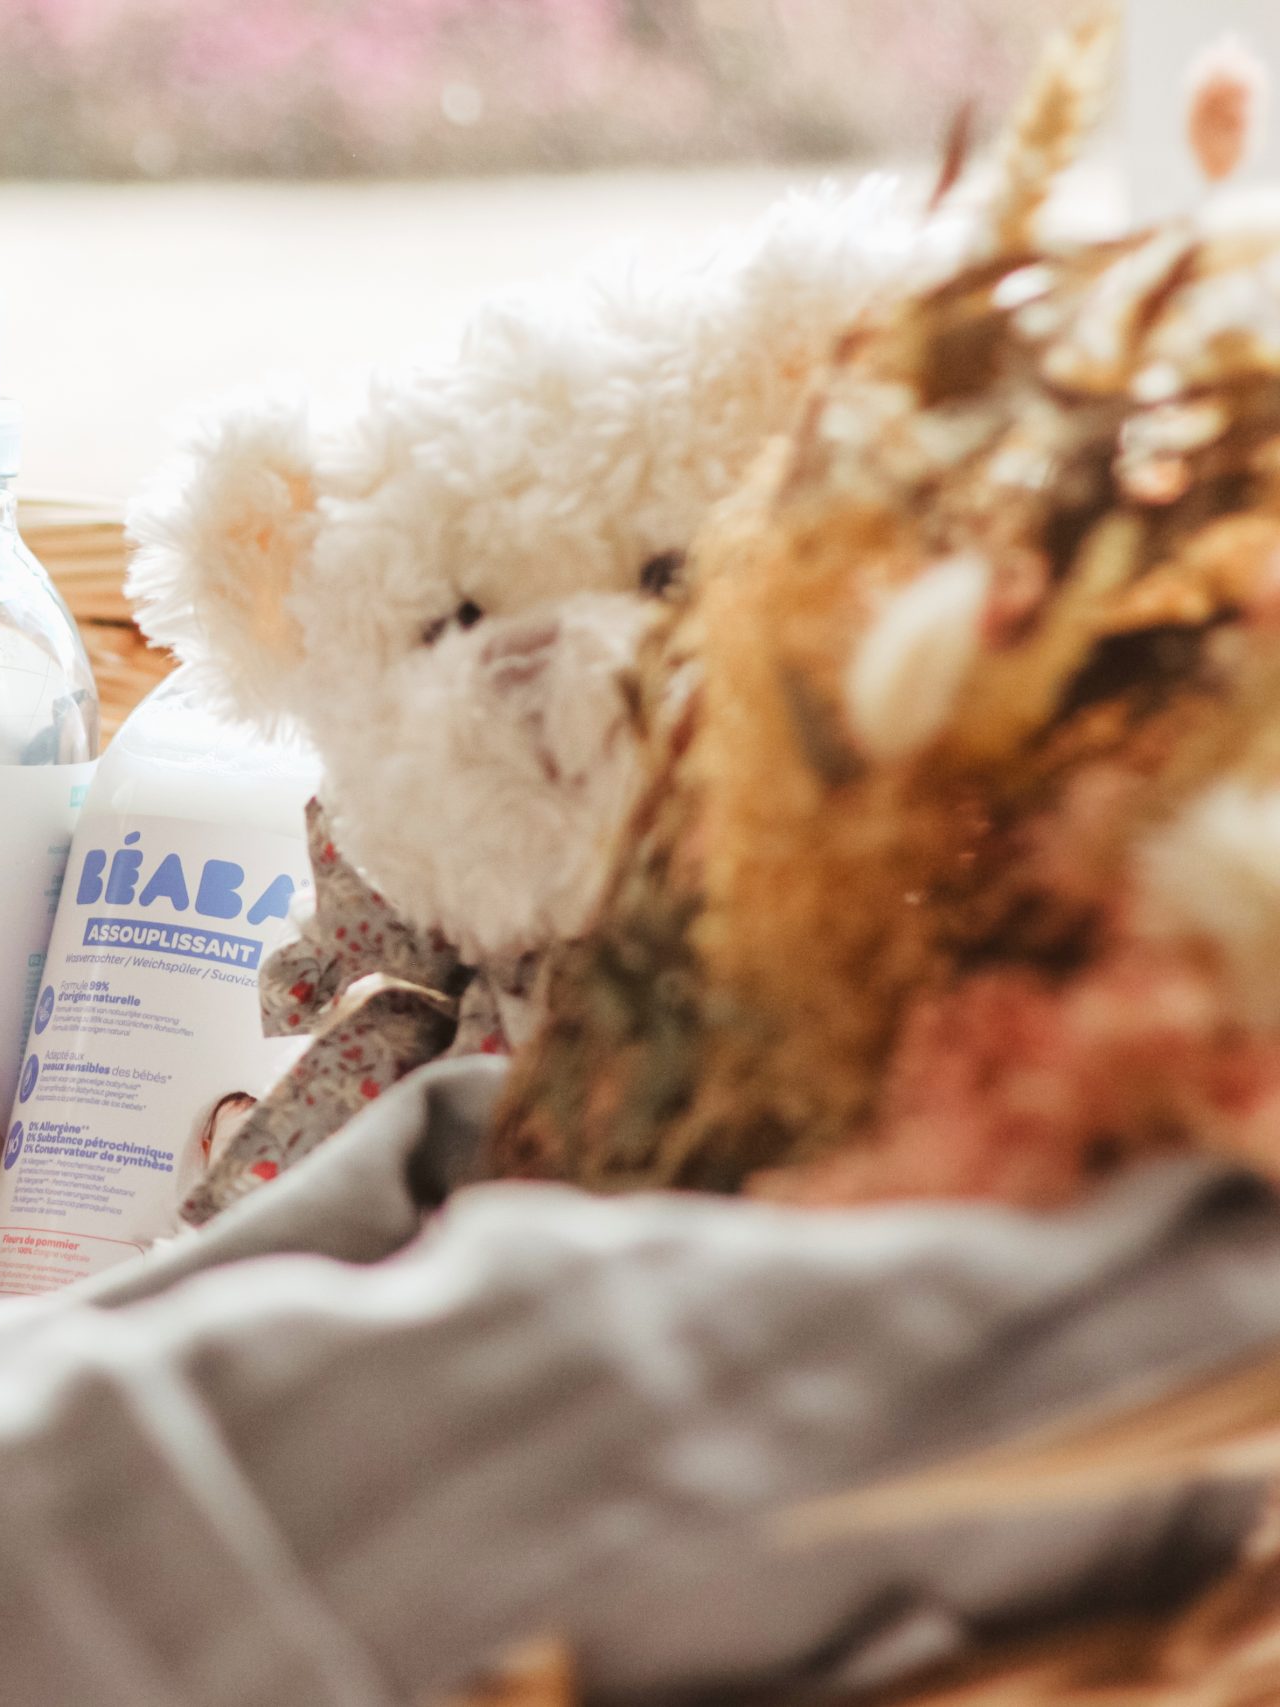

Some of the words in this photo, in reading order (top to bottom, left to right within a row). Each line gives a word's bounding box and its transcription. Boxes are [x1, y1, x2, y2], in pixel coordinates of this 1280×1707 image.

[76, 831, 295, 926] BÉABA
[88, 924, 255, 963] ASSOUPLISSANT
[66, 953, 123, 966] Wasverzachter
[132, 956, 202, 976] Weichspüler
[61, 980, 88, 991] Formule
[89, 981, 109, 992] 99%
[58, 992, 91, 1003] d'origine
[93, 994, 141, 1006] naturelle
[42, 1062, 64, 1073] peaux
[66, 1062, 110, 1075] sensibles
[112, 1066, 130, 1078] des
[29, 1121, 39, 1131] 0%
[26, 1133, 37, 1143] 0%
[37, 1133, 83, 1146] Substance
[84, 1137, 174, 1161] pétrochimique
[24, 1144, 34, 1154] 0%
[35, 1144, 96, 1159] Conservateur
[100, 1150, 114, 1162] de
[116, 1154, 174, 1172] synthèse
[3, 1234, 24, 1245] Fleurs
[25, 1236, 35, 1245] de
[35, 1237, 80, 1250] pommier
